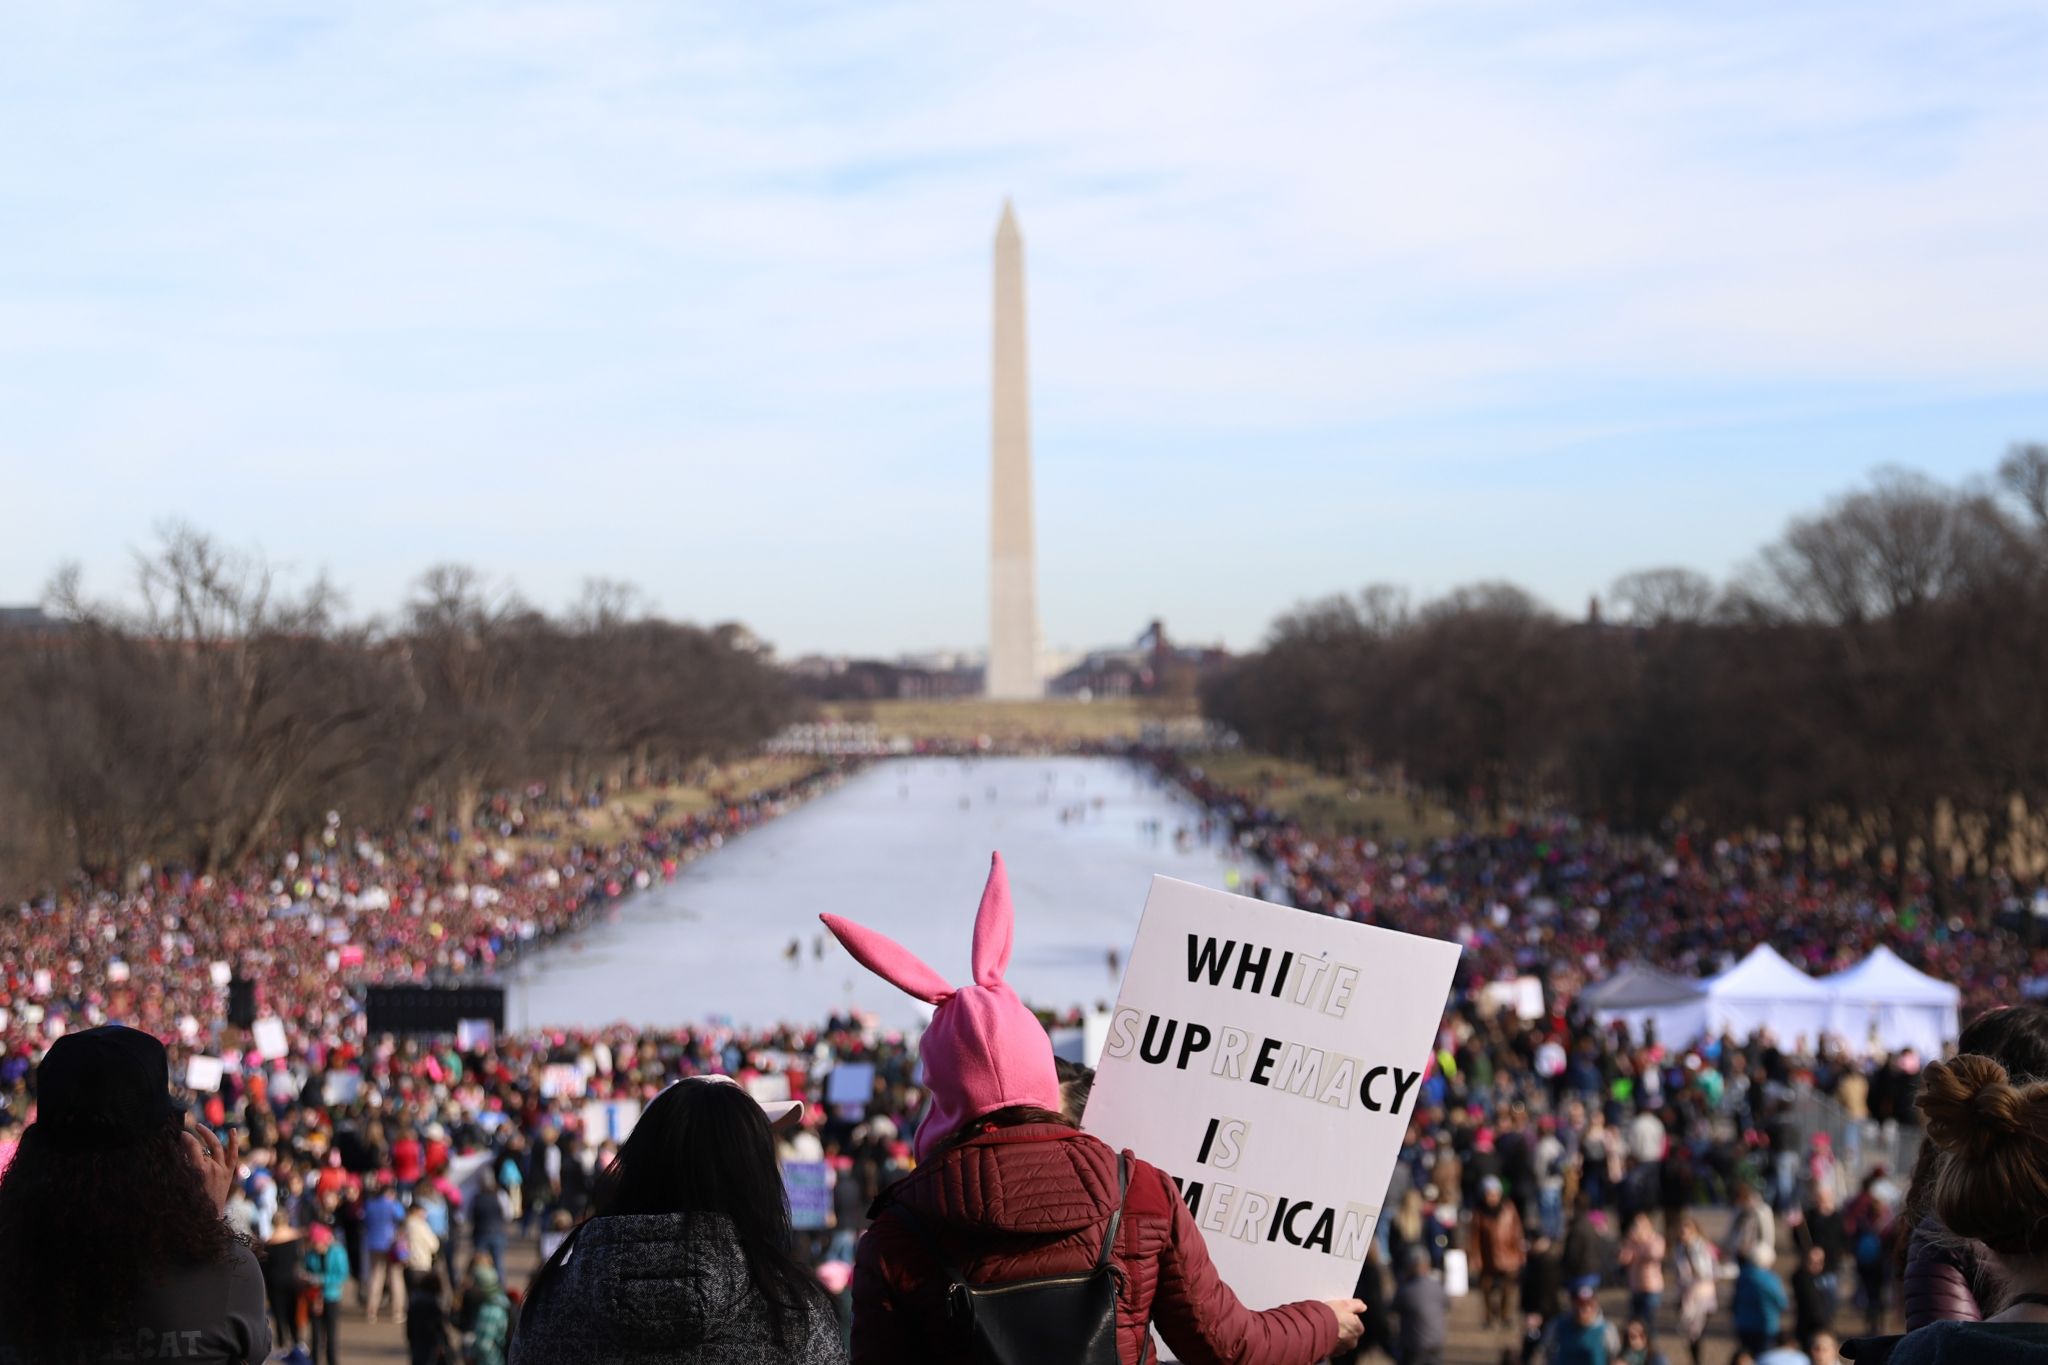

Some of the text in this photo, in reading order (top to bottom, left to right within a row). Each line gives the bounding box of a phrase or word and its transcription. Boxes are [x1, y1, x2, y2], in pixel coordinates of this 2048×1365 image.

[1187, 933, 1359, 1018] WHITE
[1107, 1008, 1421, 1115] SUPREMACY
[1197, 1118, 1247, 1169] IS
[1171, 1176, 1377, 1261] MERICAN
